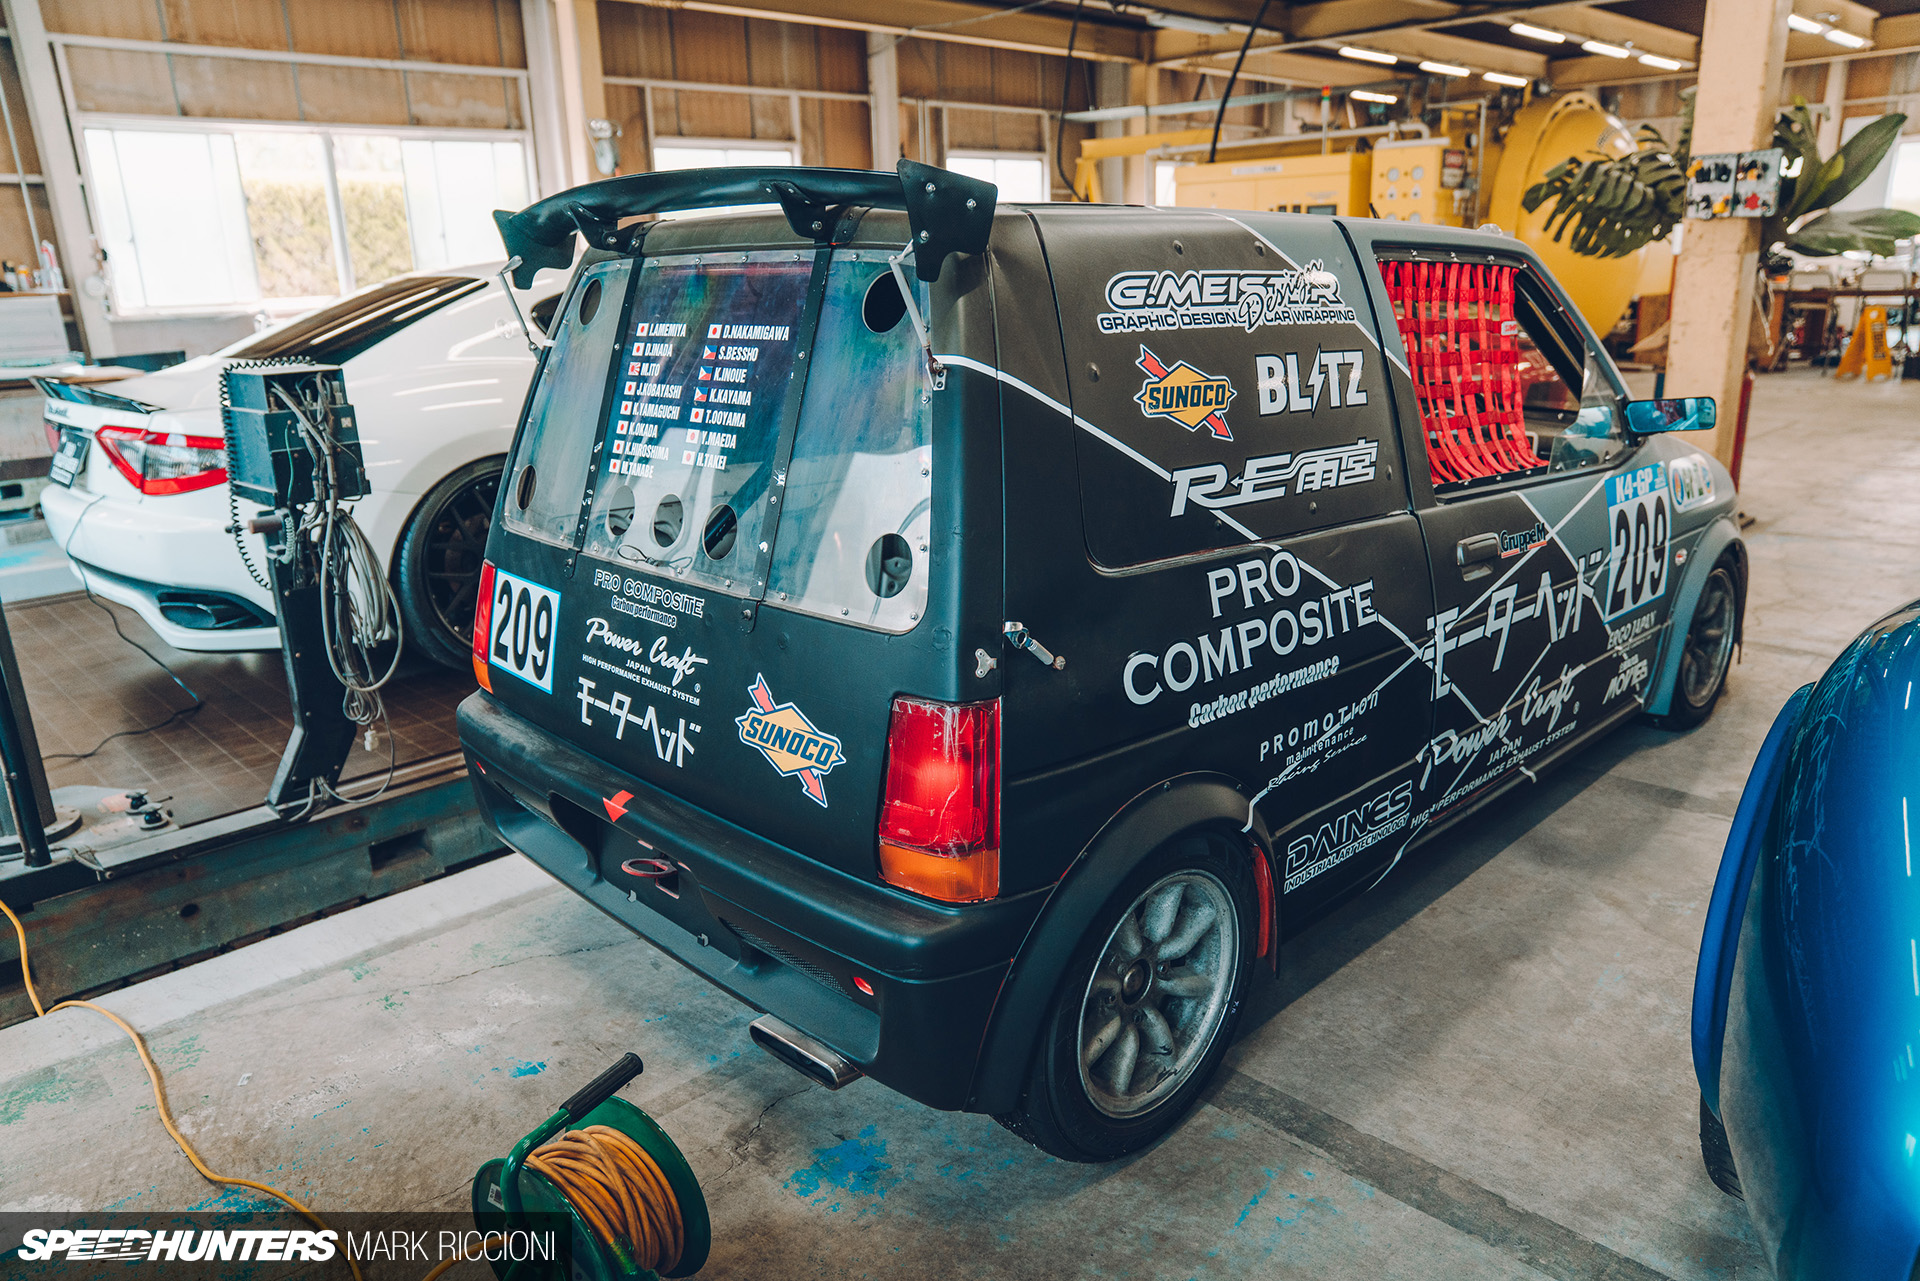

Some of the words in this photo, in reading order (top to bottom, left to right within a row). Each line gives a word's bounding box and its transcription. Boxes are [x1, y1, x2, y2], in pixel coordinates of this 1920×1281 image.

[648, 323, 687, 337] I.AMEMIYA
[722, 324, 790, 341] D.NAKAMIGAWA
[1099, 314, 1177, 332] GRAPHIC
[1180, 311, 1238, 328] DESIGN
[1292, 308, 1356, 323] WRAPPING
[644, 343, 673, 357] D.INADA
[718, 346, 759, 362] S.BESSHO
[640, 362, 660, 376] M.ITO
[713, 367, 748, 383] K.INOUE
[1254, 346, 1369, 417] BLITZ
[636, 382, 682, 399] J.KOBAYASHI
[708, 388, 752, 406] K.KAYAMA
[1149, 383, 1226, 410] SUNOCO
[632, 402, 681, 420] K.YAMAGUCHI
[705, 409, 746, 428] T.OOYAMA
[628, 421, 658, 438] K.OKADA
[701, 431, 737, 449] Y.MAEDA
[624, 441, 669, 461] K.HIROSHIMA
[696, 452, 727, 470] H.TAKEI
[620, 460, 654, 478] M.TANABE
[1615, 467, 1653, 504] K4-GP
[1500, 522, 1546, 554] GruppeM
[1608, 495, 1667, 616] 209
[594, 569, 621, 592] PRO
[623, 578, 705, 618] COMPOSITE
[1206, 551, 1301, 618] PRO
[611, 595, 634, 615] Carbon
[633, 602, 677, 628] performance
[1421, 550, 1603, 701] モーターヘッド
[494, 579, 552, 681] 209
[1122, 579, 1378, 705] COMPOSITE
[586, 617, 643, 656] Power
[649, 636, 709, 687] Craft
[625, 659, 652, 675] JAPAN
[582, 654, 597, 667] HIGH
[597, 659, 640, 683] PERFORMANCE
[641, 676, 672, 695] EXHAUST
[672, 689, 700, 706] SYSTEM
[1188, 690, 1248, 729] Carbon
[1247, 654, 1340, 709] performance
[576, 676, 702, 768] モーターヘッド
[1415, 714, 1512, 791] Power
[1520, 664, 1587, 733] Craft
[745, 716, 836, 767] SUNOCO
[1286, 726, 1354, 766] maintenance
[1322, 734, 1368, 764] Service
[1486, 735, 1522, 766] JAPAN
[1437, 762, 1506, 811] PERFORMANCE
[1505, 739, 1546, 769] EXHAUST
[1545, 720, 1577, 745] SYSTEM
[1285, 780, 1413, 878] DAINES
[1283, 853, 1340, 895] INDUSTRIAL
[1355, 812, 1410, 853] TECHNOLOGY
